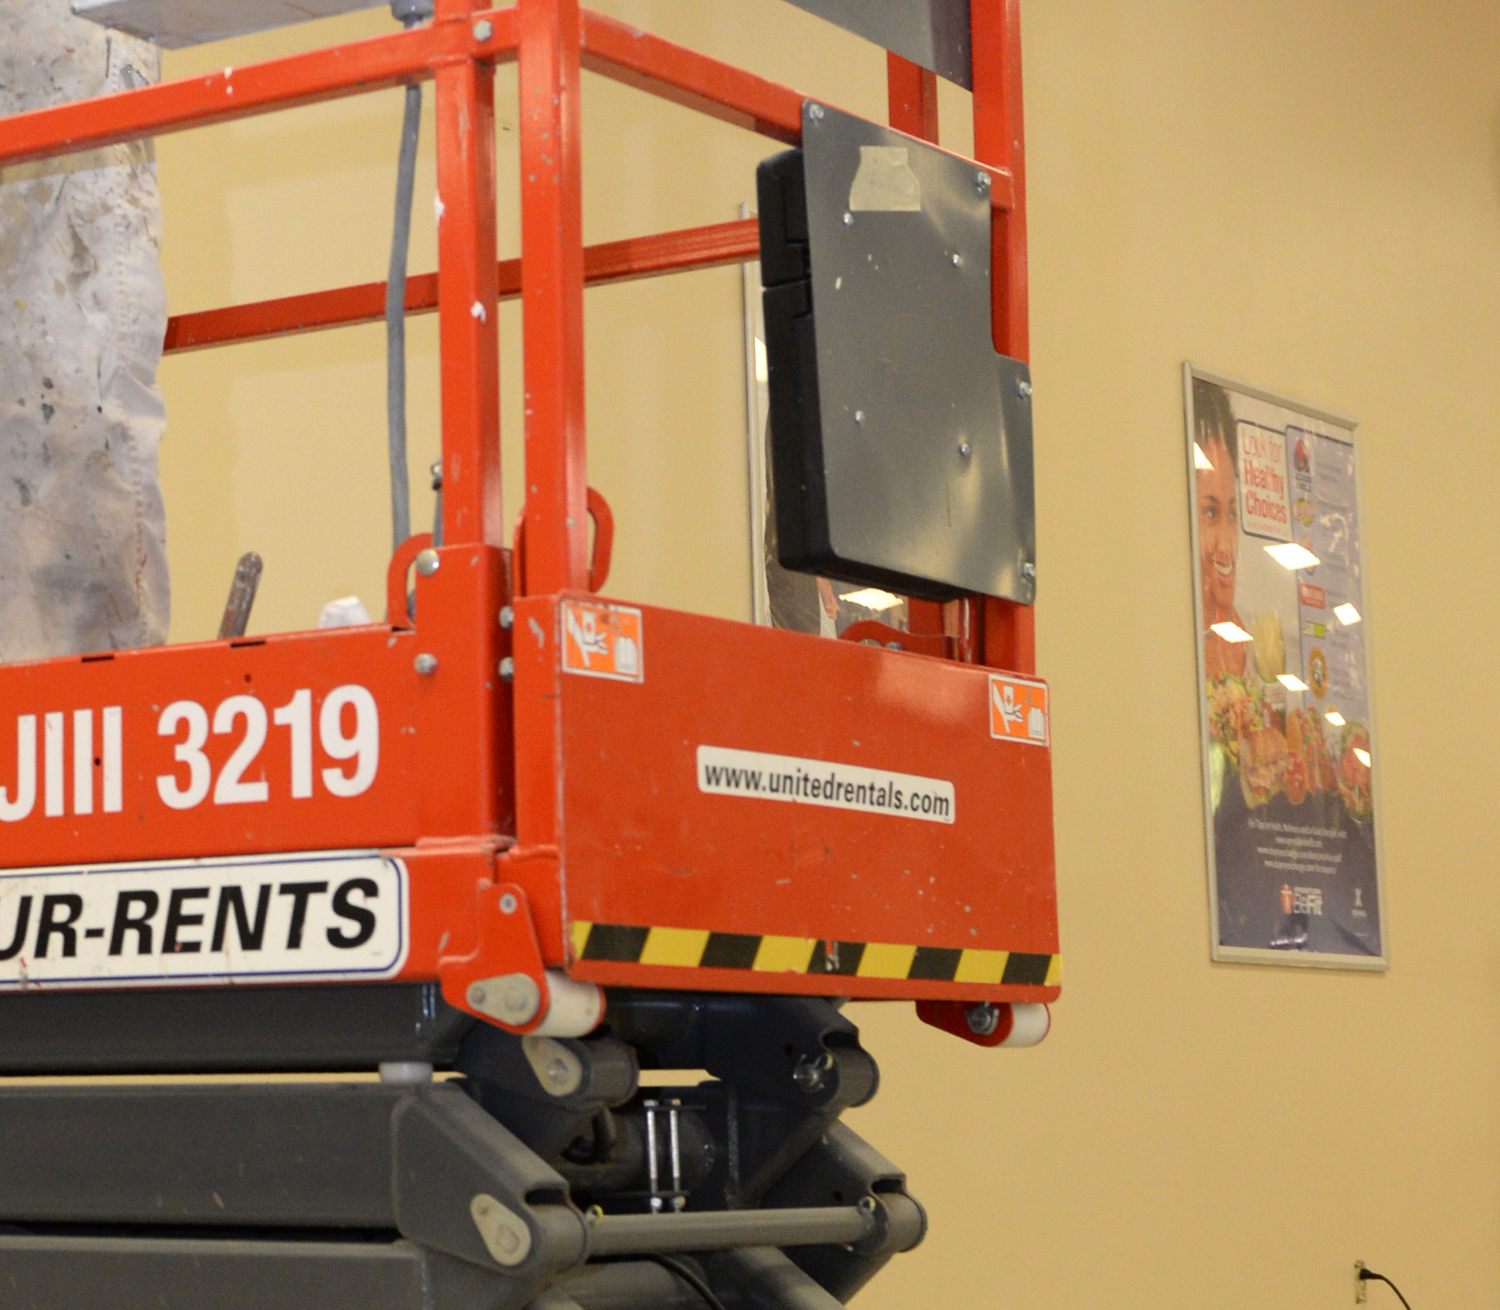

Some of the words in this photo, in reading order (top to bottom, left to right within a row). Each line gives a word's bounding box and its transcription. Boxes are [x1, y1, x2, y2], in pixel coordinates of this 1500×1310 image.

[1243, 458, 1285, 501] Healthy
[1245, 488, 1288, 525] Choices
[155, 684, 380, 810] 3219
[704, 764, 950, 817] www.unitedrentals.com
